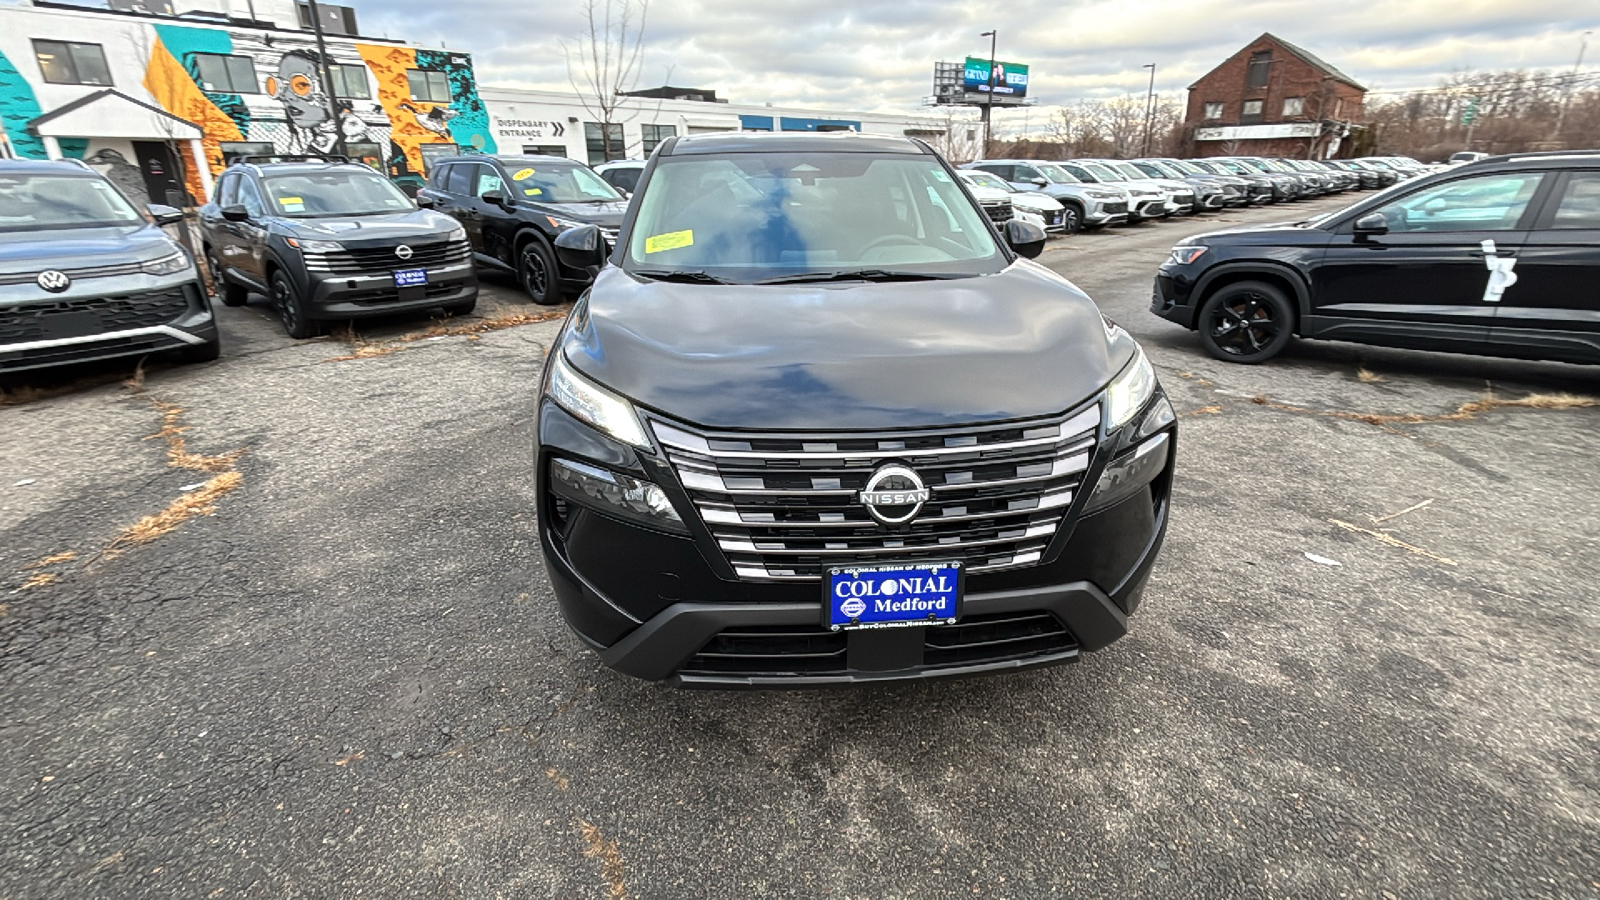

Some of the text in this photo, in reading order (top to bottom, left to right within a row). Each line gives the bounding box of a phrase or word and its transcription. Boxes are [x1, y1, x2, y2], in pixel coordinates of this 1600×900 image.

[498, 119, 548, 128] DISPENSARY
[499, 129, 542, 137] ENTRANCE
[862, 492, 928, 503] NISSAN
[836, 576, 953, 597] COLONIAL
[874, 596, 946, 613] Medford
